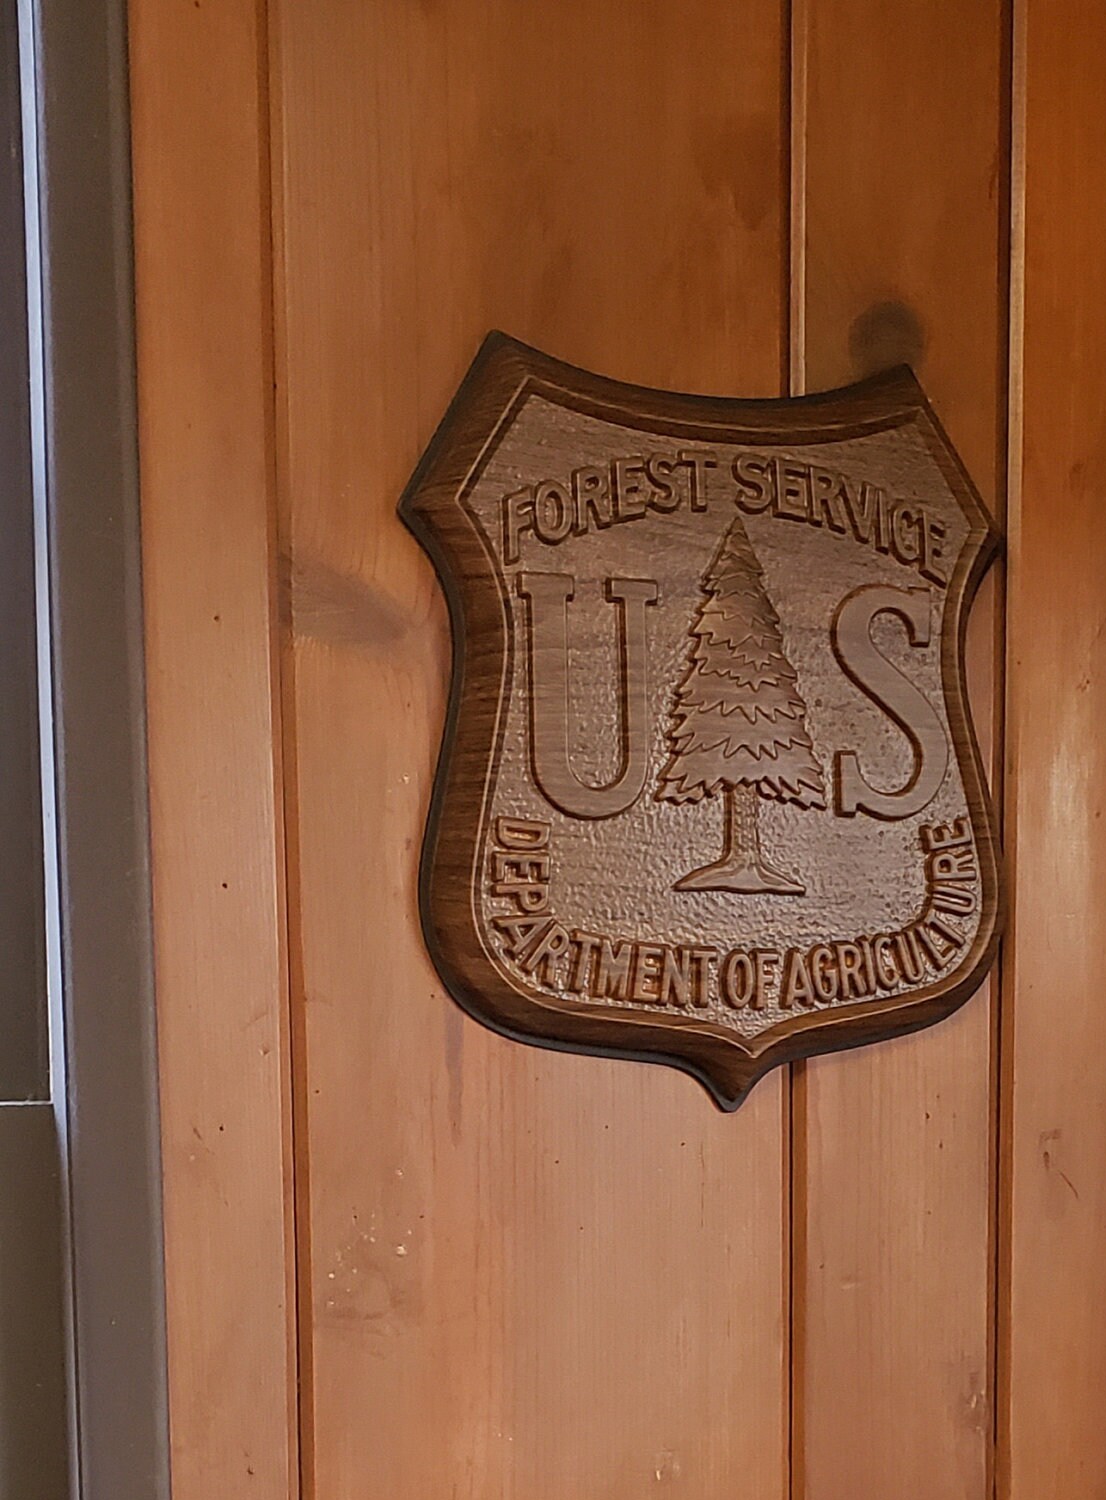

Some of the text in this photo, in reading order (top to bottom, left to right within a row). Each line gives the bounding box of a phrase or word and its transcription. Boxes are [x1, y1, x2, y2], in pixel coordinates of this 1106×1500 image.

[502, 450, 948, 586] FOREST SERVICE
[515, 570, 951, 821] U S
[488, 815, 978, 1009] DEPARTMENT OF AGRICULTURE
